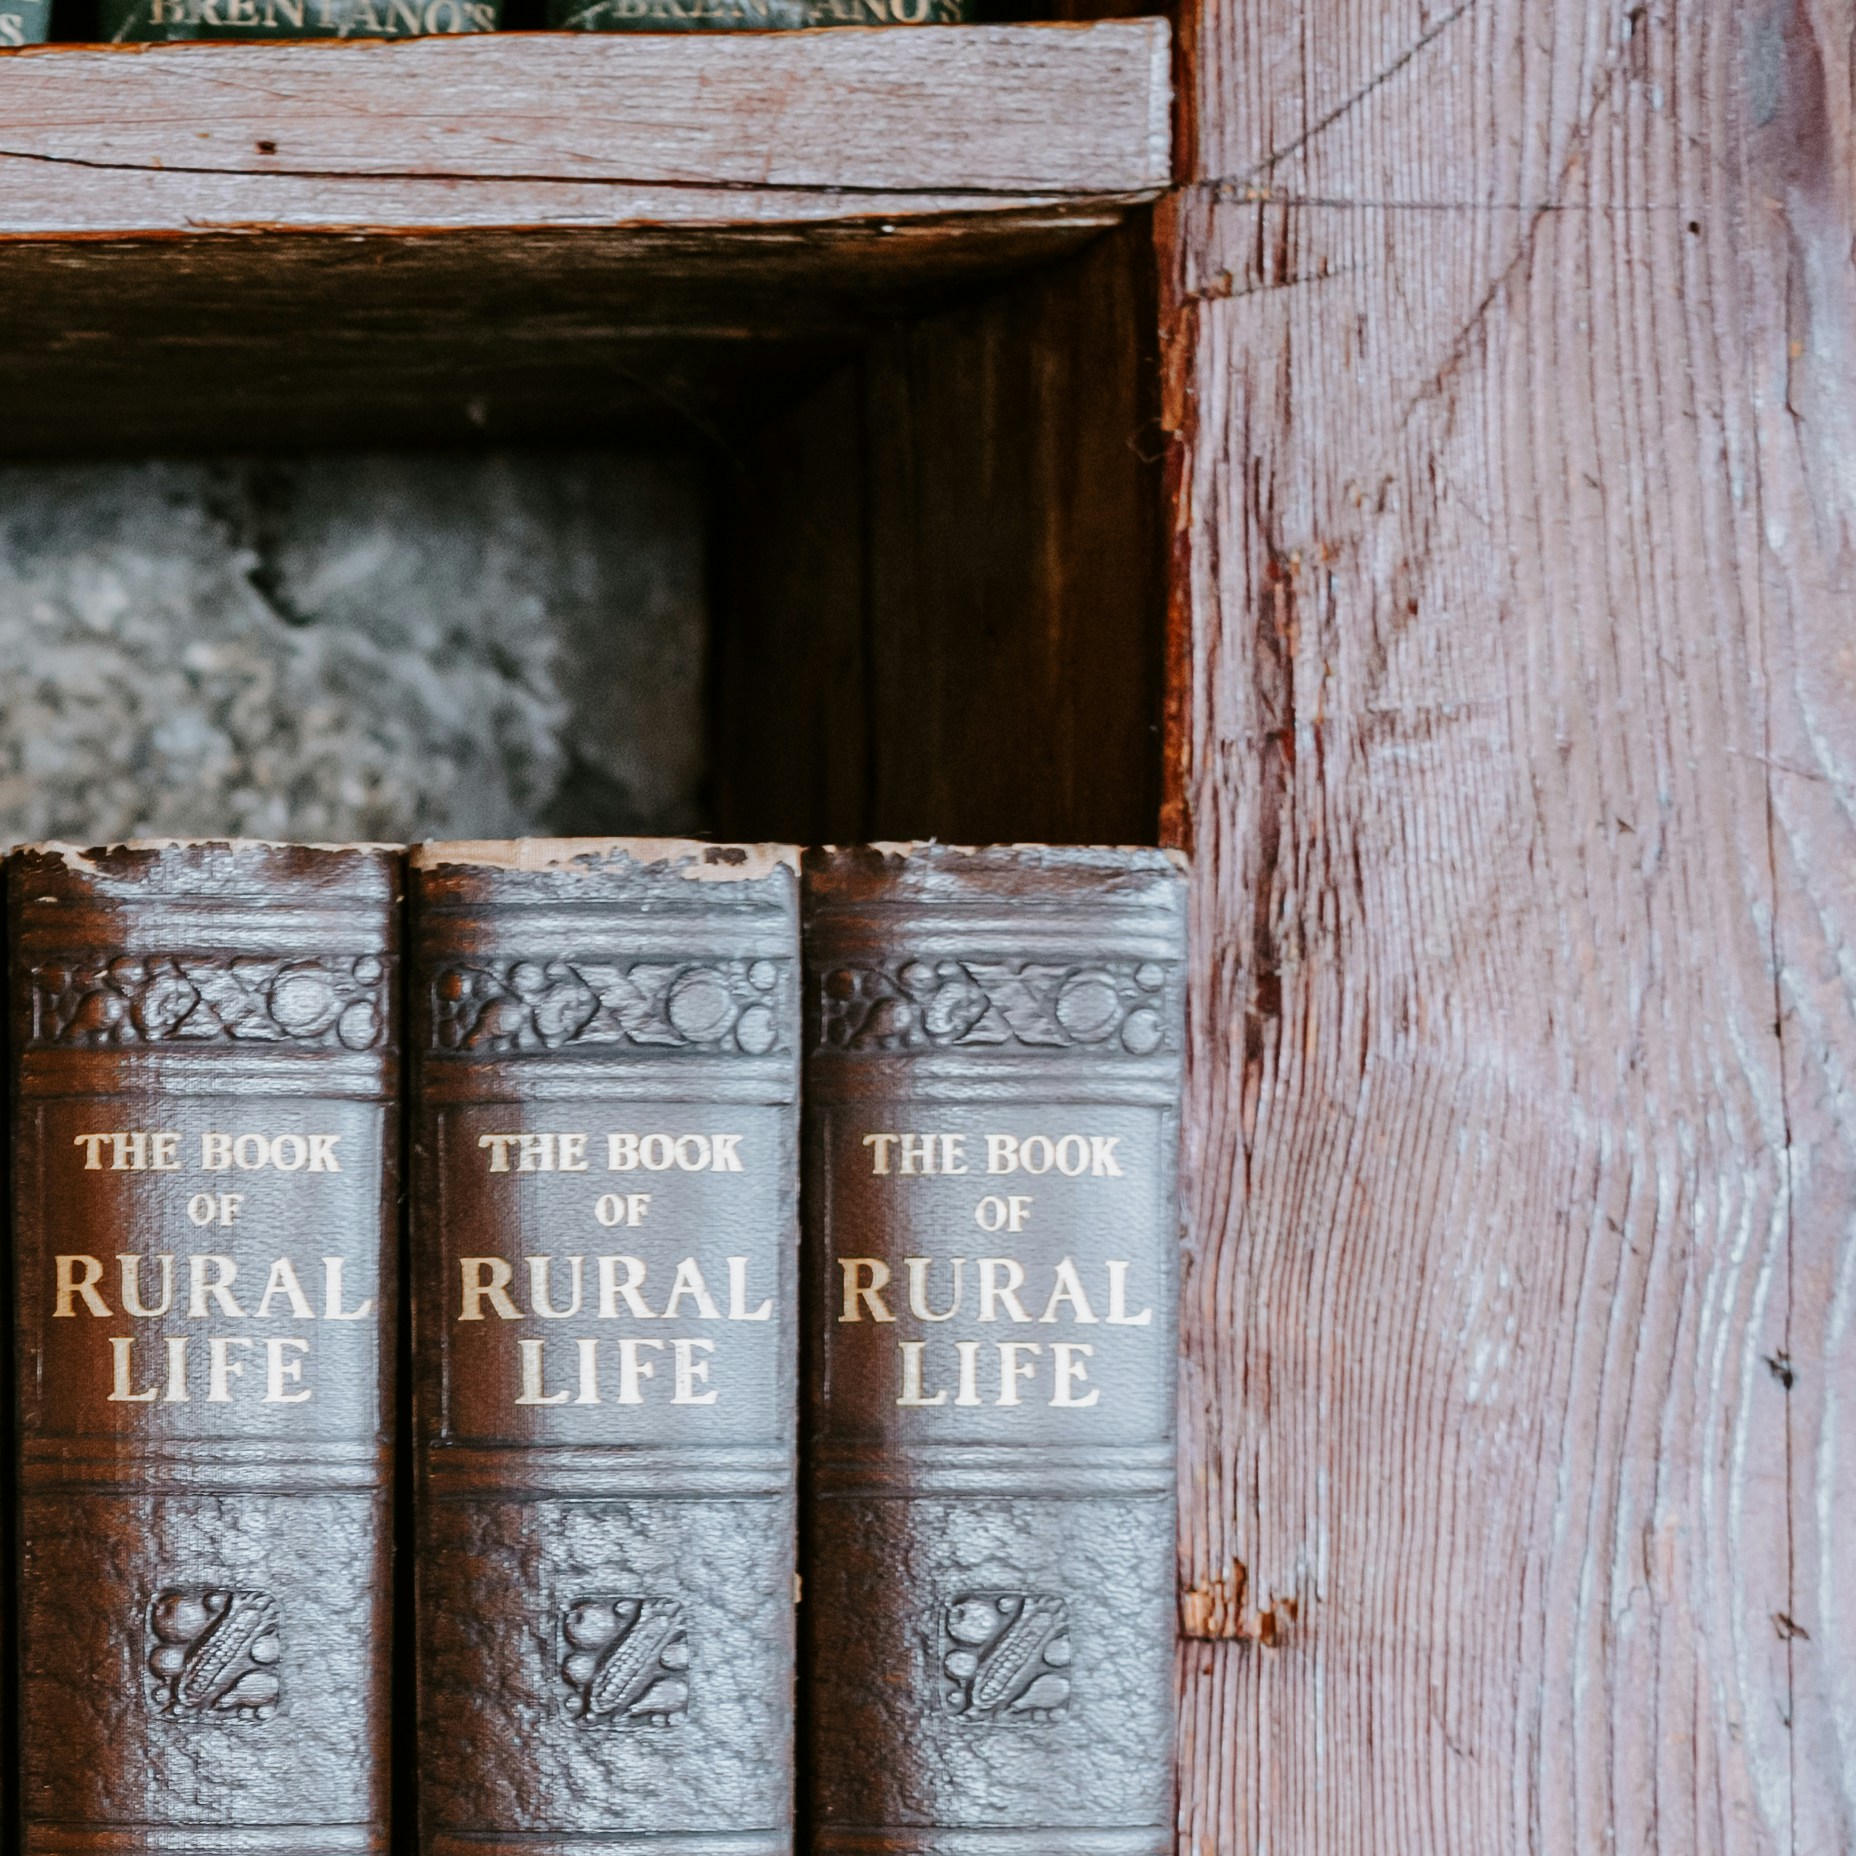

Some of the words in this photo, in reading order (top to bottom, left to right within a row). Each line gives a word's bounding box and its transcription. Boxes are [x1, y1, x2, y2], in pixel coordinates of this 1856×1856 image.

[74, 1133, 181, 1171] THE
[201, 1134, 342, 1173] BOOK
[479, 1133, 588, 1172] THE
[606, 1134, 744, 1173] BOOK
[862, 1134, 968, 1175] THE
[986, 1135, 1122, 1177] BOOK
[53, 1254, 374, 1321] RURAL
[457, 1256, 773, 1321] RURAL
[837, 1257, 1152, 1326] RURAL
[107, 1337, 312, 1403] LIFE
[515, 1339, 718, 1405] LIFE
[897, 1341, 1101, 1408] LIFE
